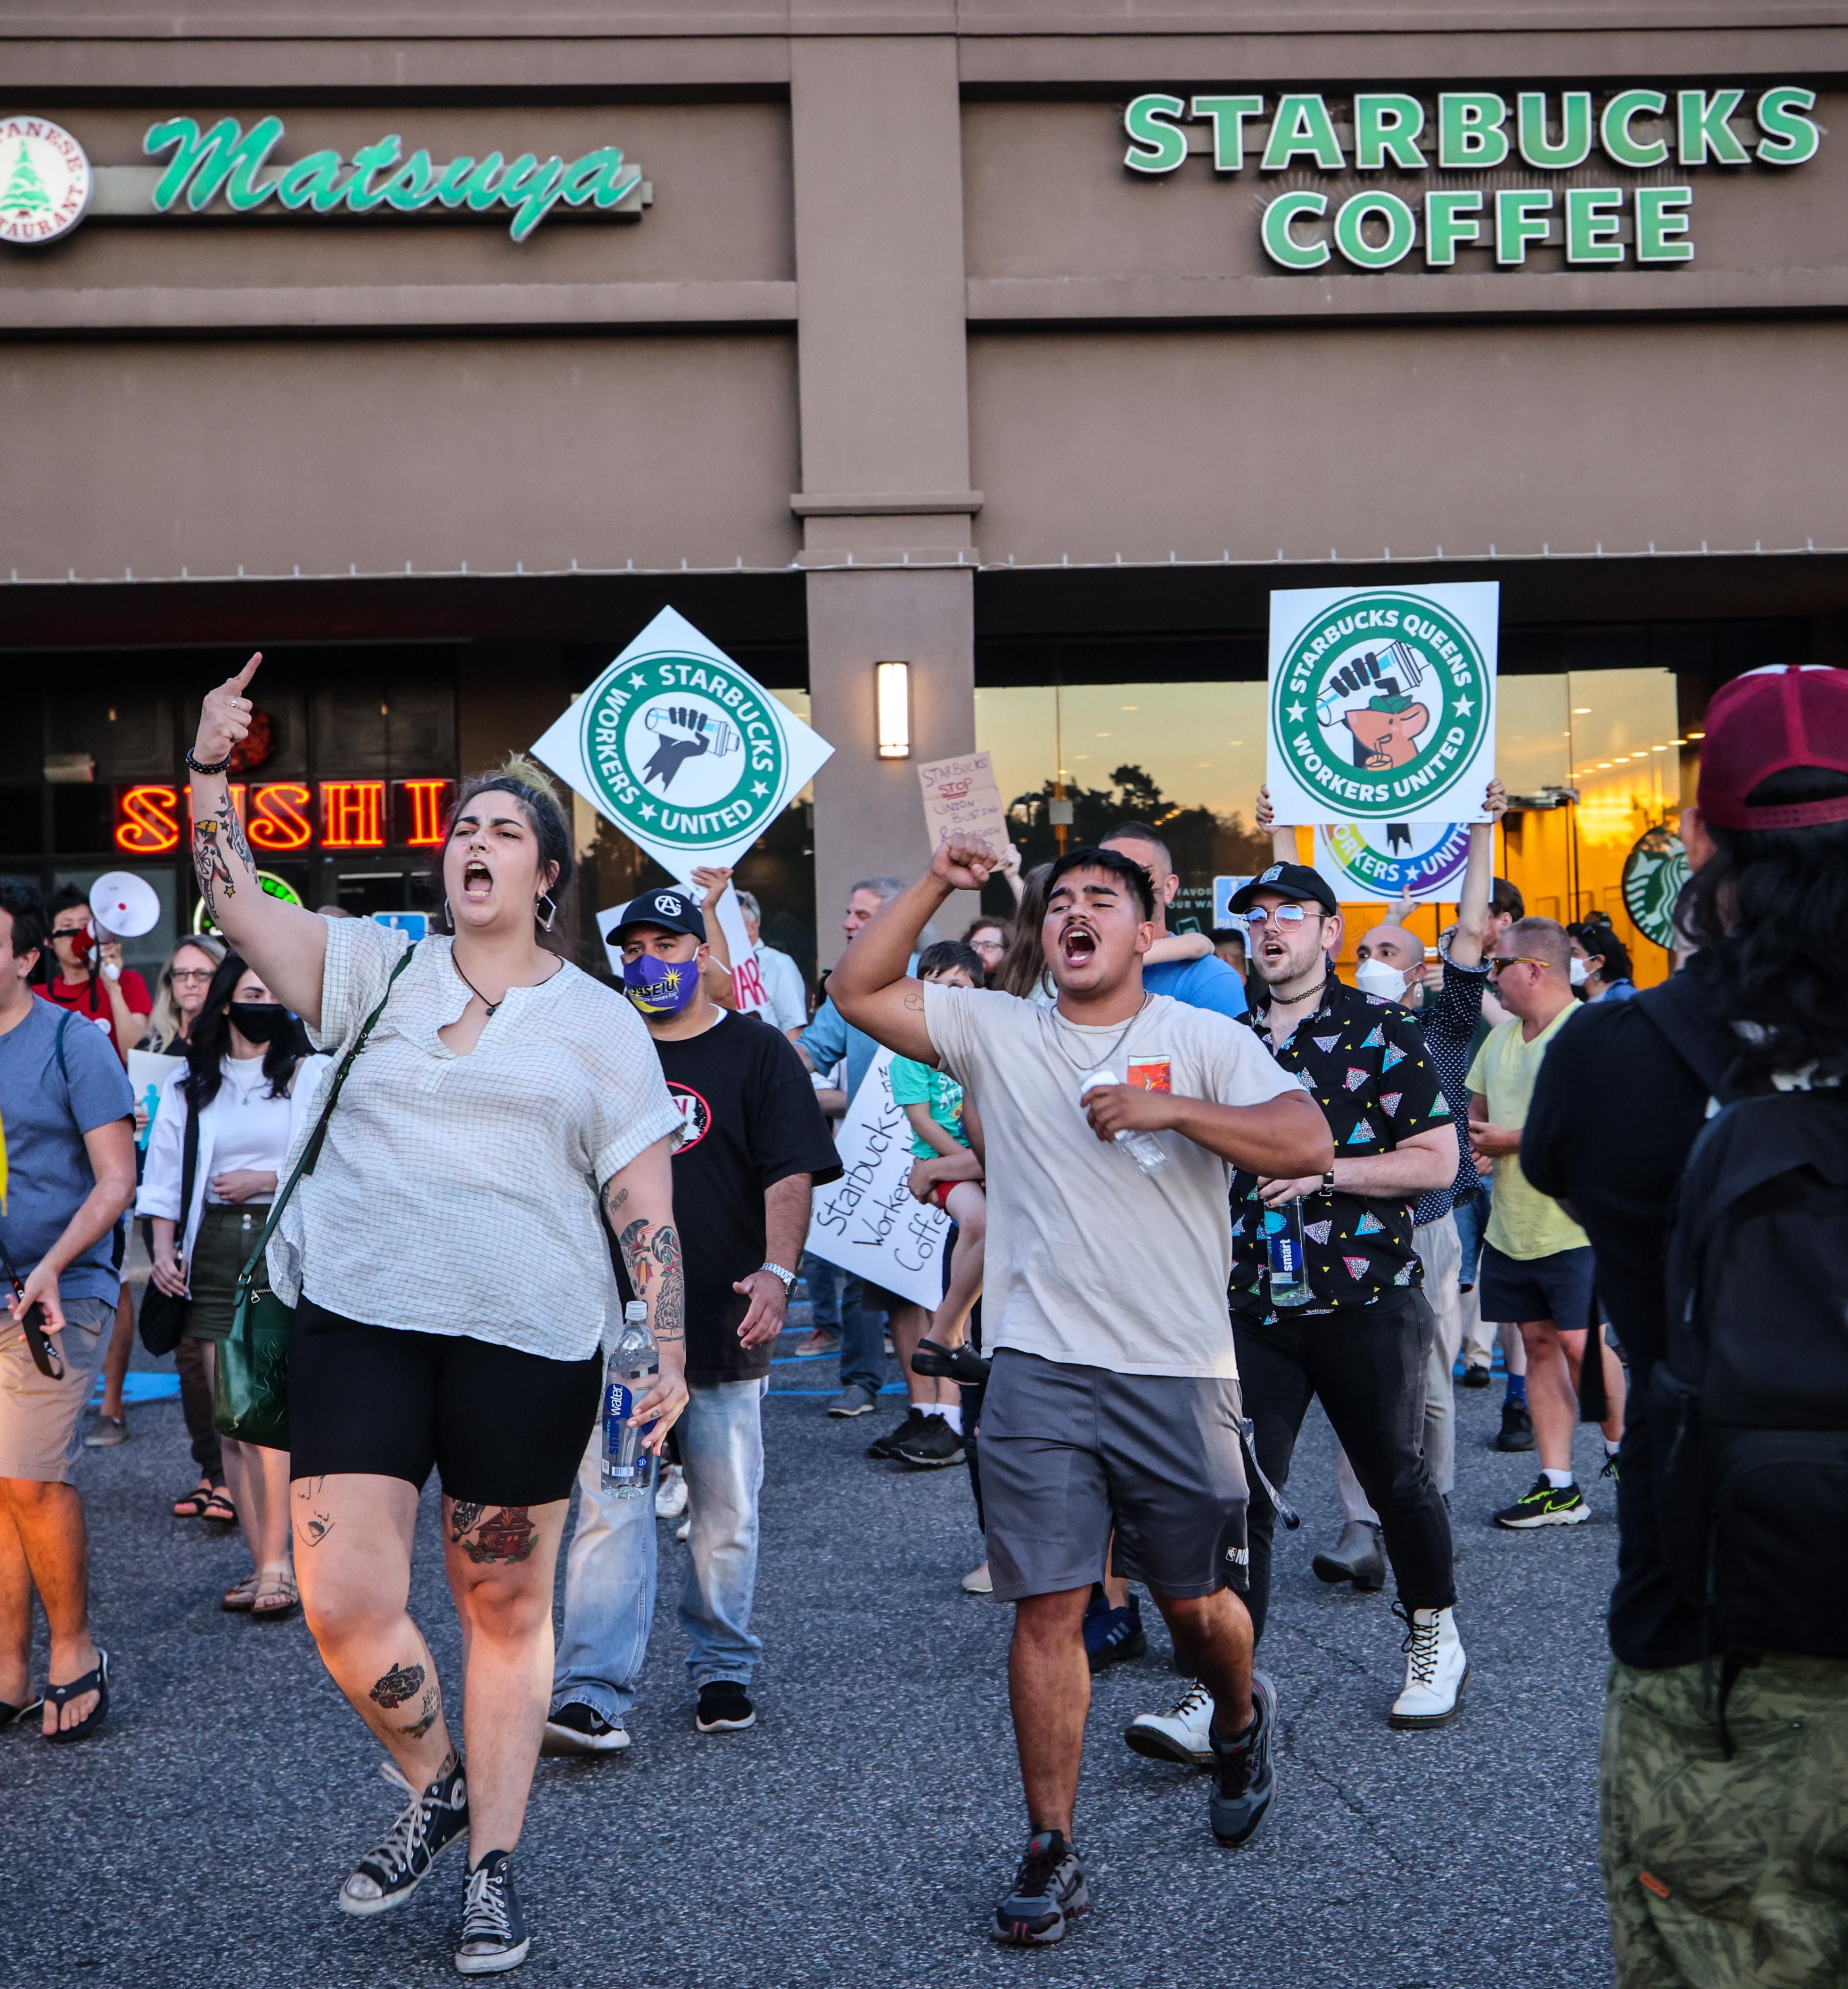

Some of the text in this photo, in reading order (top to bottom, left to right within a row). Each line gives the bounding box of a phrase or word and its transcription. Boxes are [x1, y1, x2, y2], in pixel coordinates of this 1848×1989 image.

[0, 121, 83, 172] ANESE
[1124, 86, 1820, 173] STARBUCKS
[143, 114, 641, 243] Matsuya
[1260, 186, 1695, 270] COFFEE
[1289, 610, 1472, 694] STARBUCKS QUEENS
[658, 664, 774, 773] STARBUCKS
[595, 688, 753, 834] WORKERS UNITED
[922, 758, 988, 787] STARBUCKS
[938, 777, 973, 795] STOP
[1292, 726, 1465, 802] WORKERS UNITED
[1333, 823, 1470, 882] ORKERS UNITE
[1195, 900, 1212, 908] WA
[817, 1102, 904, 1236] Starbucks
[895, 1209, 948, 1272] Coffe
[1280, 1238, 1293, 1271] smart
[610, 1384, 623, 1416] water
